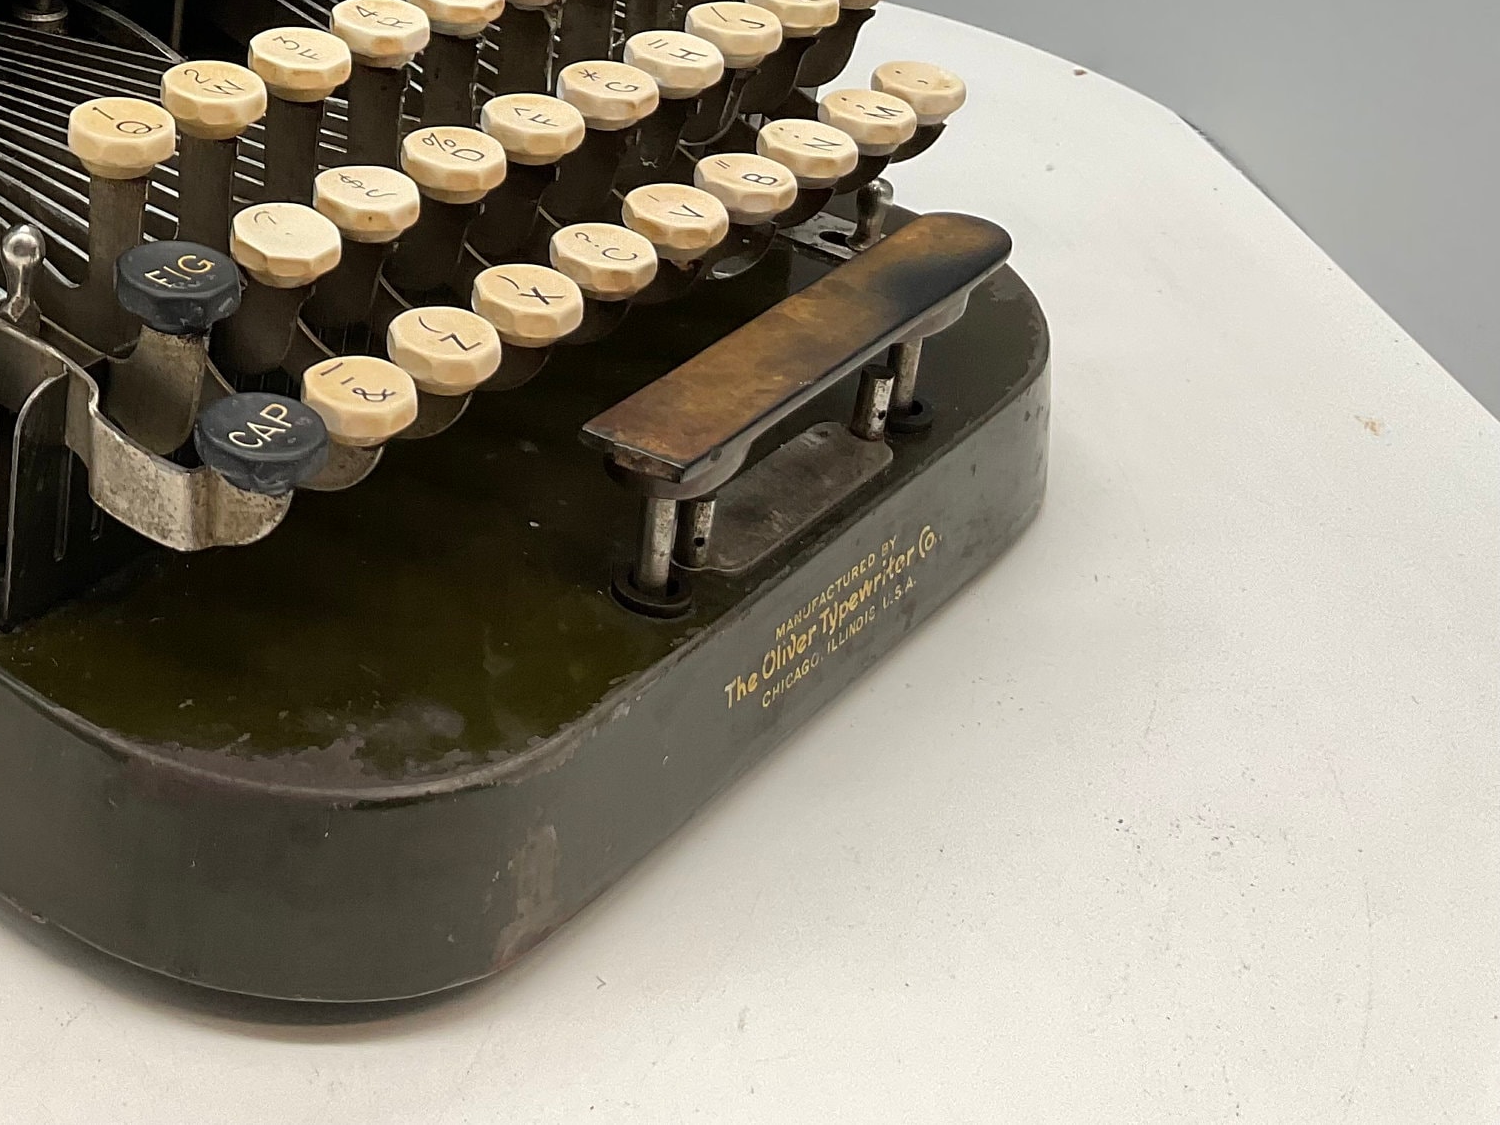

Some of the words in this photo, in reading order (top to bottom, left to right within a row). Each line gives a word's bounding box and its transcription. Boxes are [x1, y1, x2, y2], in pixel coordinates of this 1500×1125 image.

[355, 5, 379, 18] 4
[376, 17, 413, 29] R
[272, 36, 300, 51] 3
[669, 48, 708, 62] H
[184, 69, 210, 84] 2
[203, 79, 245, 96] W
[605, 81, 638, 93] G
[92, 105, 115, 121] 1
[528, 113, 558, 127] F
[864, 105, 903, 120] M
[115, 120, 164, 135] Q
[803, 137, 842, 151] N
[450, 148, 484, 162] D
[741, 173, 778, 186] B
[668, 204, 704, 218] V
[601, 248, 638, 260] C
[144, 254, 216, 289] FIG
[518, 287, 566, 305] X
[439, 333, 482, 351] Z
[228, 403, 292, 449] CAP
[775, 553, 875, 641] MANUFACTURED
[881, 535, 897, 557] BY
[724, 672, 758, 708] The
[762, 625, 817, 679] Oliver
[819, 546, 915, 635] Typewriter
[827, 605, 876, 655] ILLINOIS
